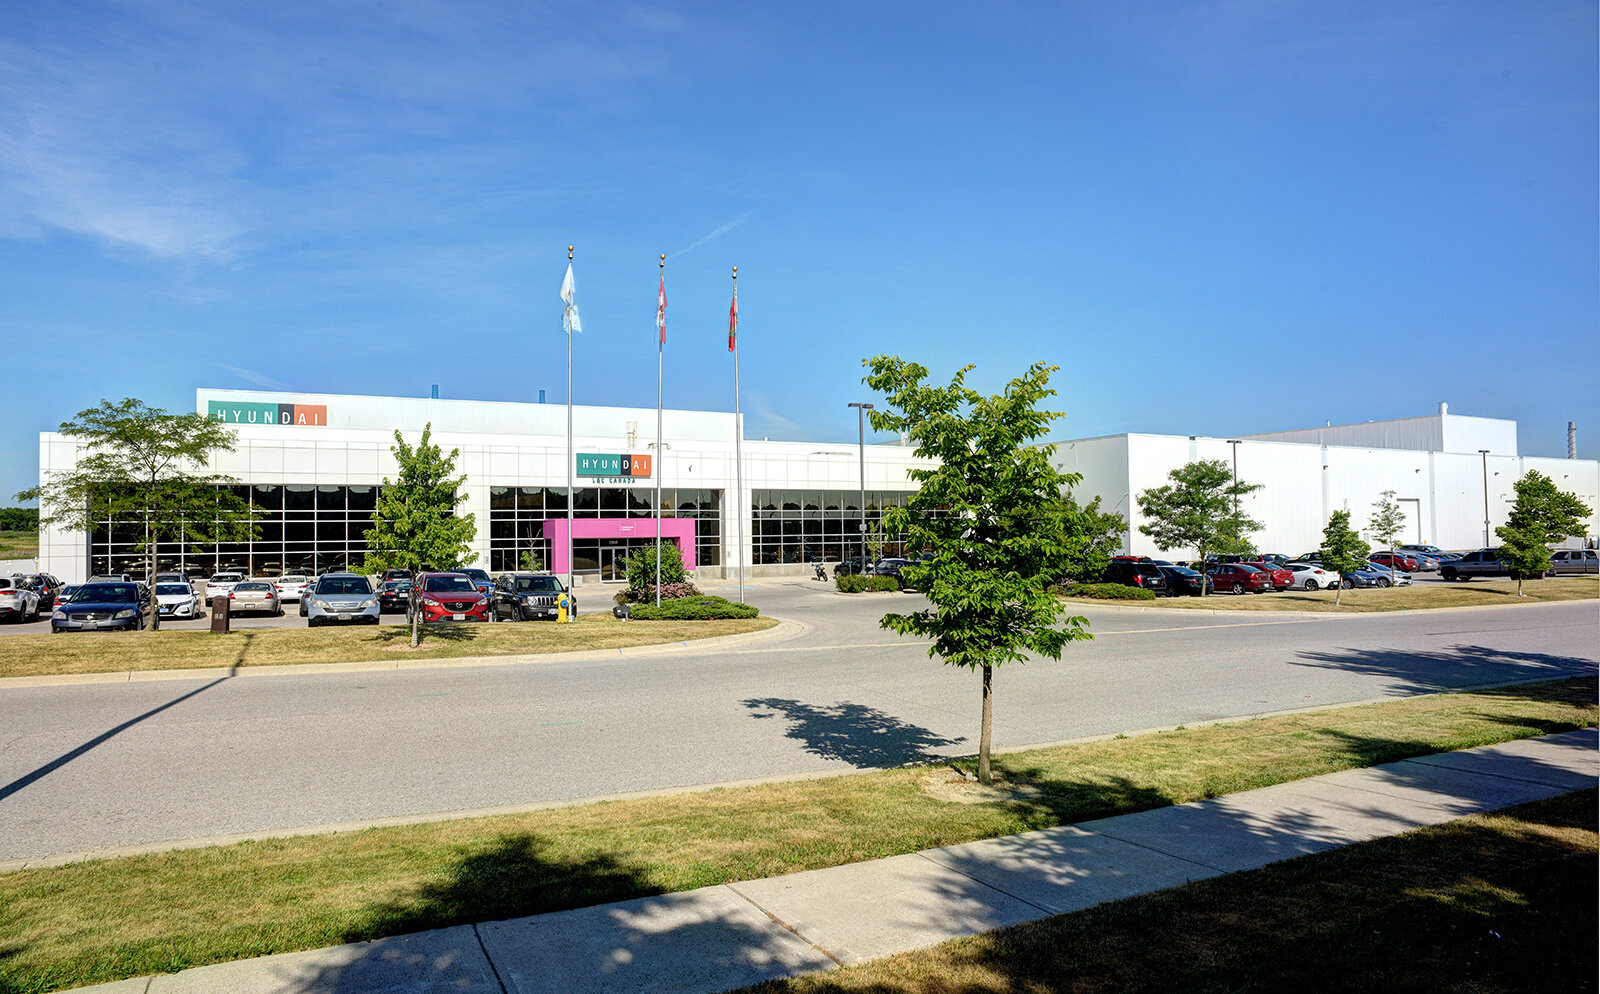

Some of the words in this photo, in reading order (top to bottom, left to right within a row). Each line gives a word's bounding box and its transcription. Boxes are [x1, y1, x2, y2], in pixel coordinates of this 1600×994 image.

[217, 409, 318, 425] HYUNDAI
[582, 459, 647, 470] HYUNDAI
[609, 476, 636, 484] CANADA
